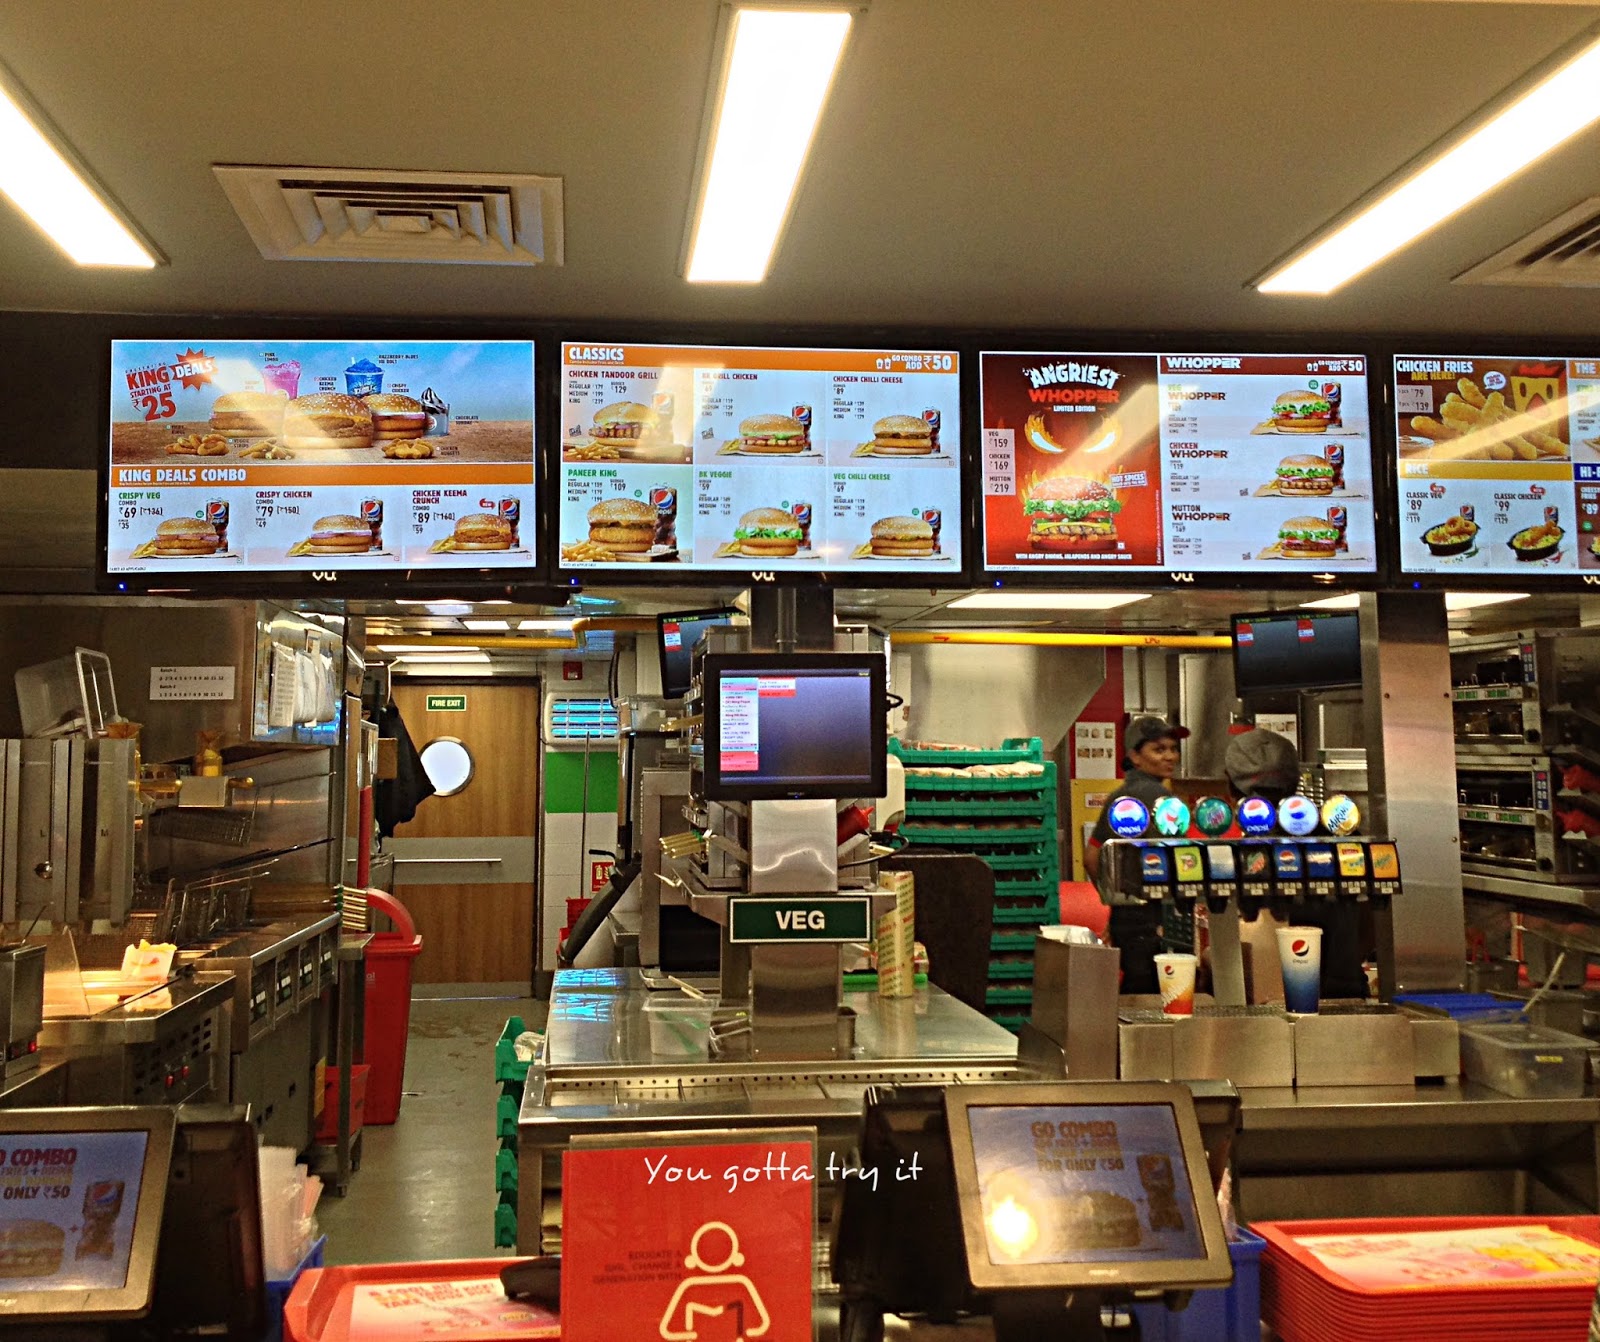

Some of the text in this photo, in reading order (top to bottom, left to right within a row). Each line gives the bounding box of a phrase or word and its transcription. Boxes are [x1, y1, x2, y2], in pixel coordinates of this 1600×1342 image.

[569, 348, 624, 360] CLASSICS
[1166, 357, 1241, 368] WHOPPER
[1397, 360, 1474, 373] CHICKEN FRIES
[1575, 363, 1596, 374] THE
[126, 360, 213, 390] KING DEALS
[1028, 362, 1120, 389] ANGRIEST
[1411, 372, 1428, 381] ARE
[130, 386, 162, 398] STARTING
[1028, 389, 1119, 403] WHOPPER
[1168, 392, 1226, 400] WHOPPER
[1170, 450, 1228, 458] WHOPPER
[119, 469, 246, 482] KING DEALS COMBO
[1172, 513, 1230, 521] WHOPPER
[1118, 825, 1141, 834] pepsi
[775, 910, 825, 930] VEG
[1032, 1120, 1117, 1137] GO COMBO
[11, 1148, 77, 1166] COMBO
[1066, 1159, 1096, 1171] ONLY
[4, 1186, 40, 1199] ONLY
